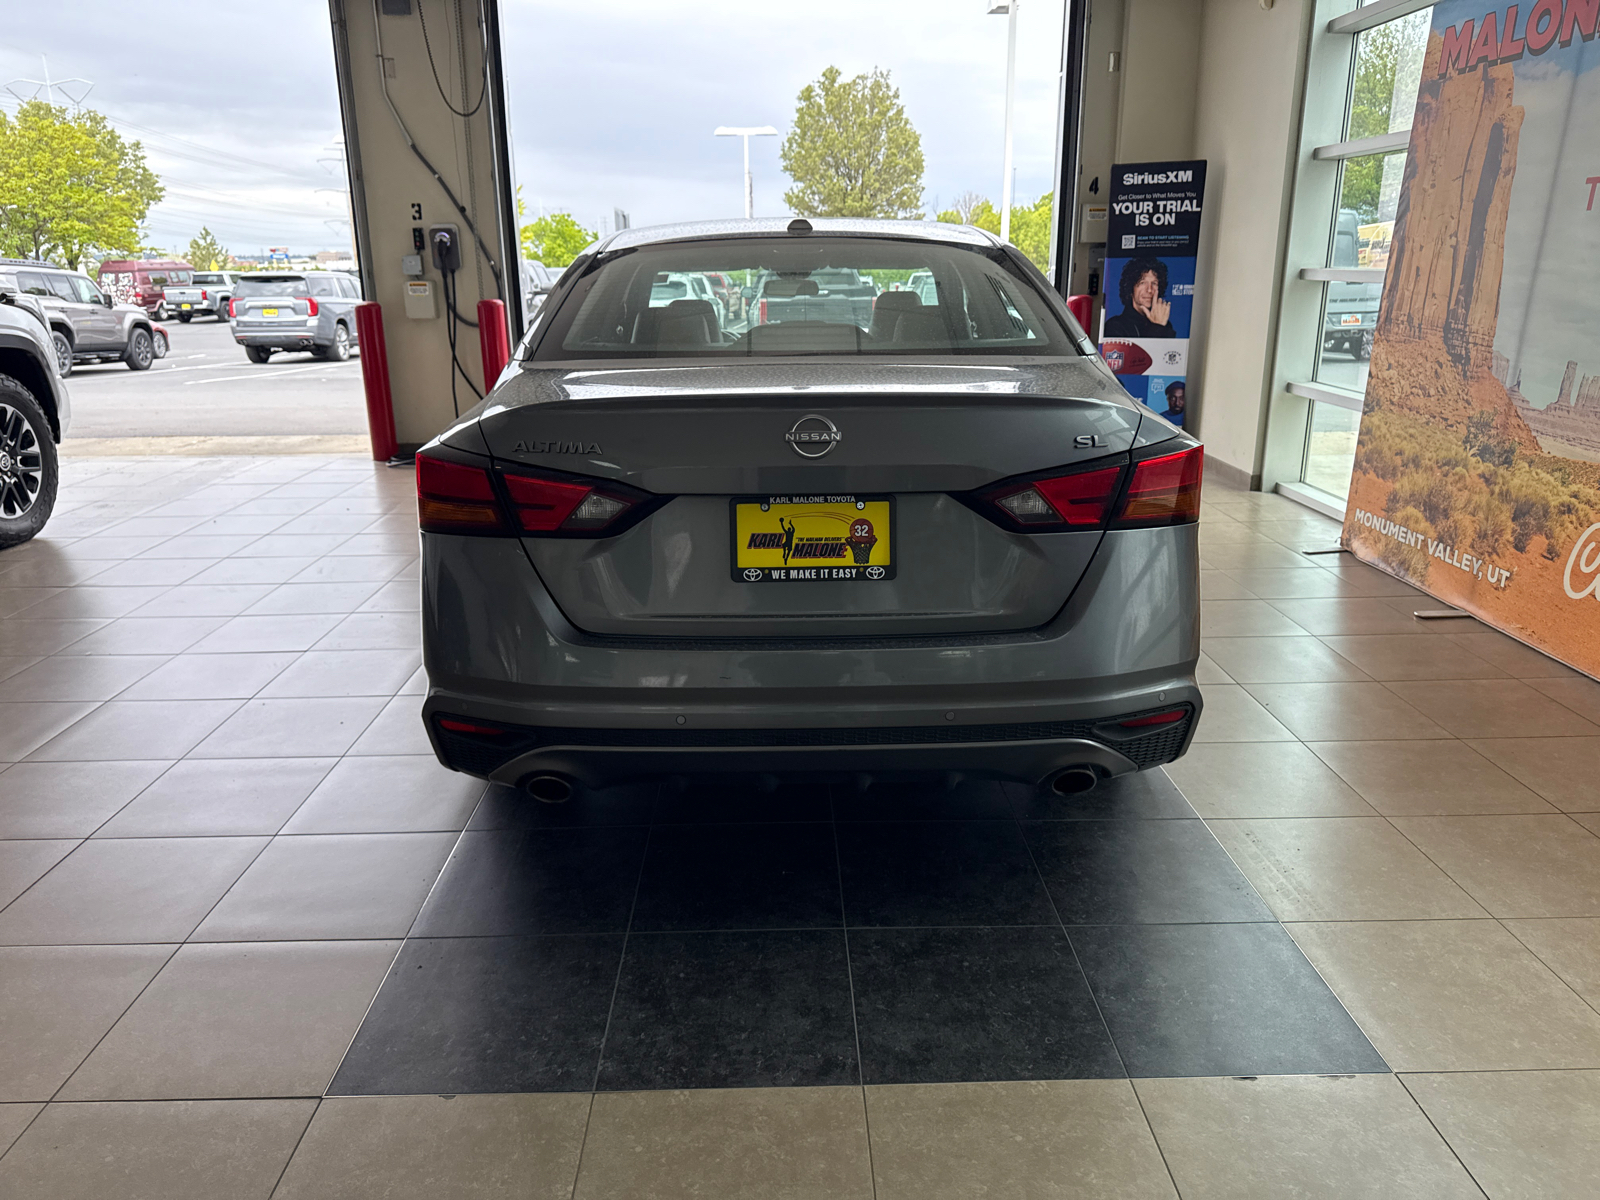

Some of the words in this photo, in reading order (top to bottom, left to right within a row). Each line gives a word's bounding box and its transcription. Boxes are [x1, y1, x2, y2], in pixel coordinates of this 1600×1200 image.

[1438, 0, 1600, 80] MALON
[1089, 176, 1099, 195] 4
[1123, 170, 1193, 186] SiriusXM
[411, 203, 422, 221] 3
[1112, 201, 1153, 215] YOUR
[1157, 199, 1201, 213] TRIAL
[1135, 214, 1150, 227] IS
[1152, 213, 1176, 226] ON
[785, 433, 840, 441] NISSAN
[1073, 434, 1109, 449] SL
[512, 440, 603, 455] ALTIMA
[792, 496, 826, 504] MALONE
[826, 495, 856, 503] TOYOTA
[854, 524, 869, 537] 32
[747, 532, 785, 549] KARL
[1354, 508, 1425, 550] MONUMENT
[1427, 538, 1483, 582] VALLEY,
[1486, 563, 1511, 588] UT
[791, 542, 848, 559] MALONE
[771, 569, 786, 580] WE
[790, 569, 817, 579] MAKE
[820, 569, 829, 578] IT
[832, 568, 857, 578] EASY
